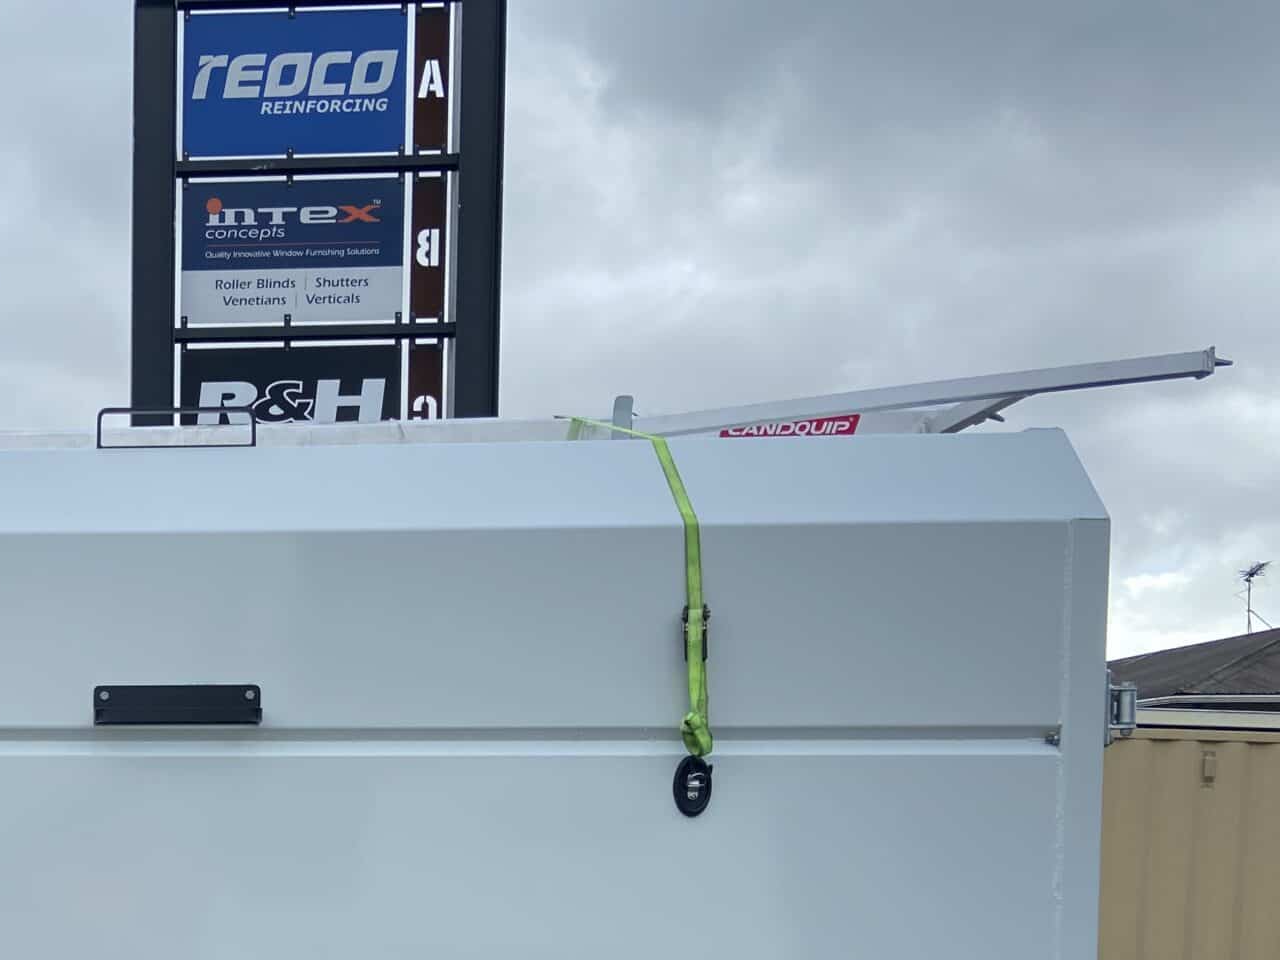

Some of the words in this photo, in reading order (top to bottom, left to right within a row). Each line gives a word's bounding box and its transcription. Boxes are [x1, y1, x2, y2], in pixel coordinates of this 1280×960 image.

[260, 98, 389, 115] REINFORCING
[205, 226, 286, 241] concepts
[272, 249, 304, 257] Window
[305, 247, 345, 258] Furnishing
[346, 247, 380, 256] Solutions
[215, 279, 253, 291] Roller
[256, 278, 297, 290] Blinds
[315, 276, 369, 288] Shutters
[222, 295, 287, 307] Venetians
[305, 293, 361, 305] Verticals
[197, 378, 386, 424] R&H
